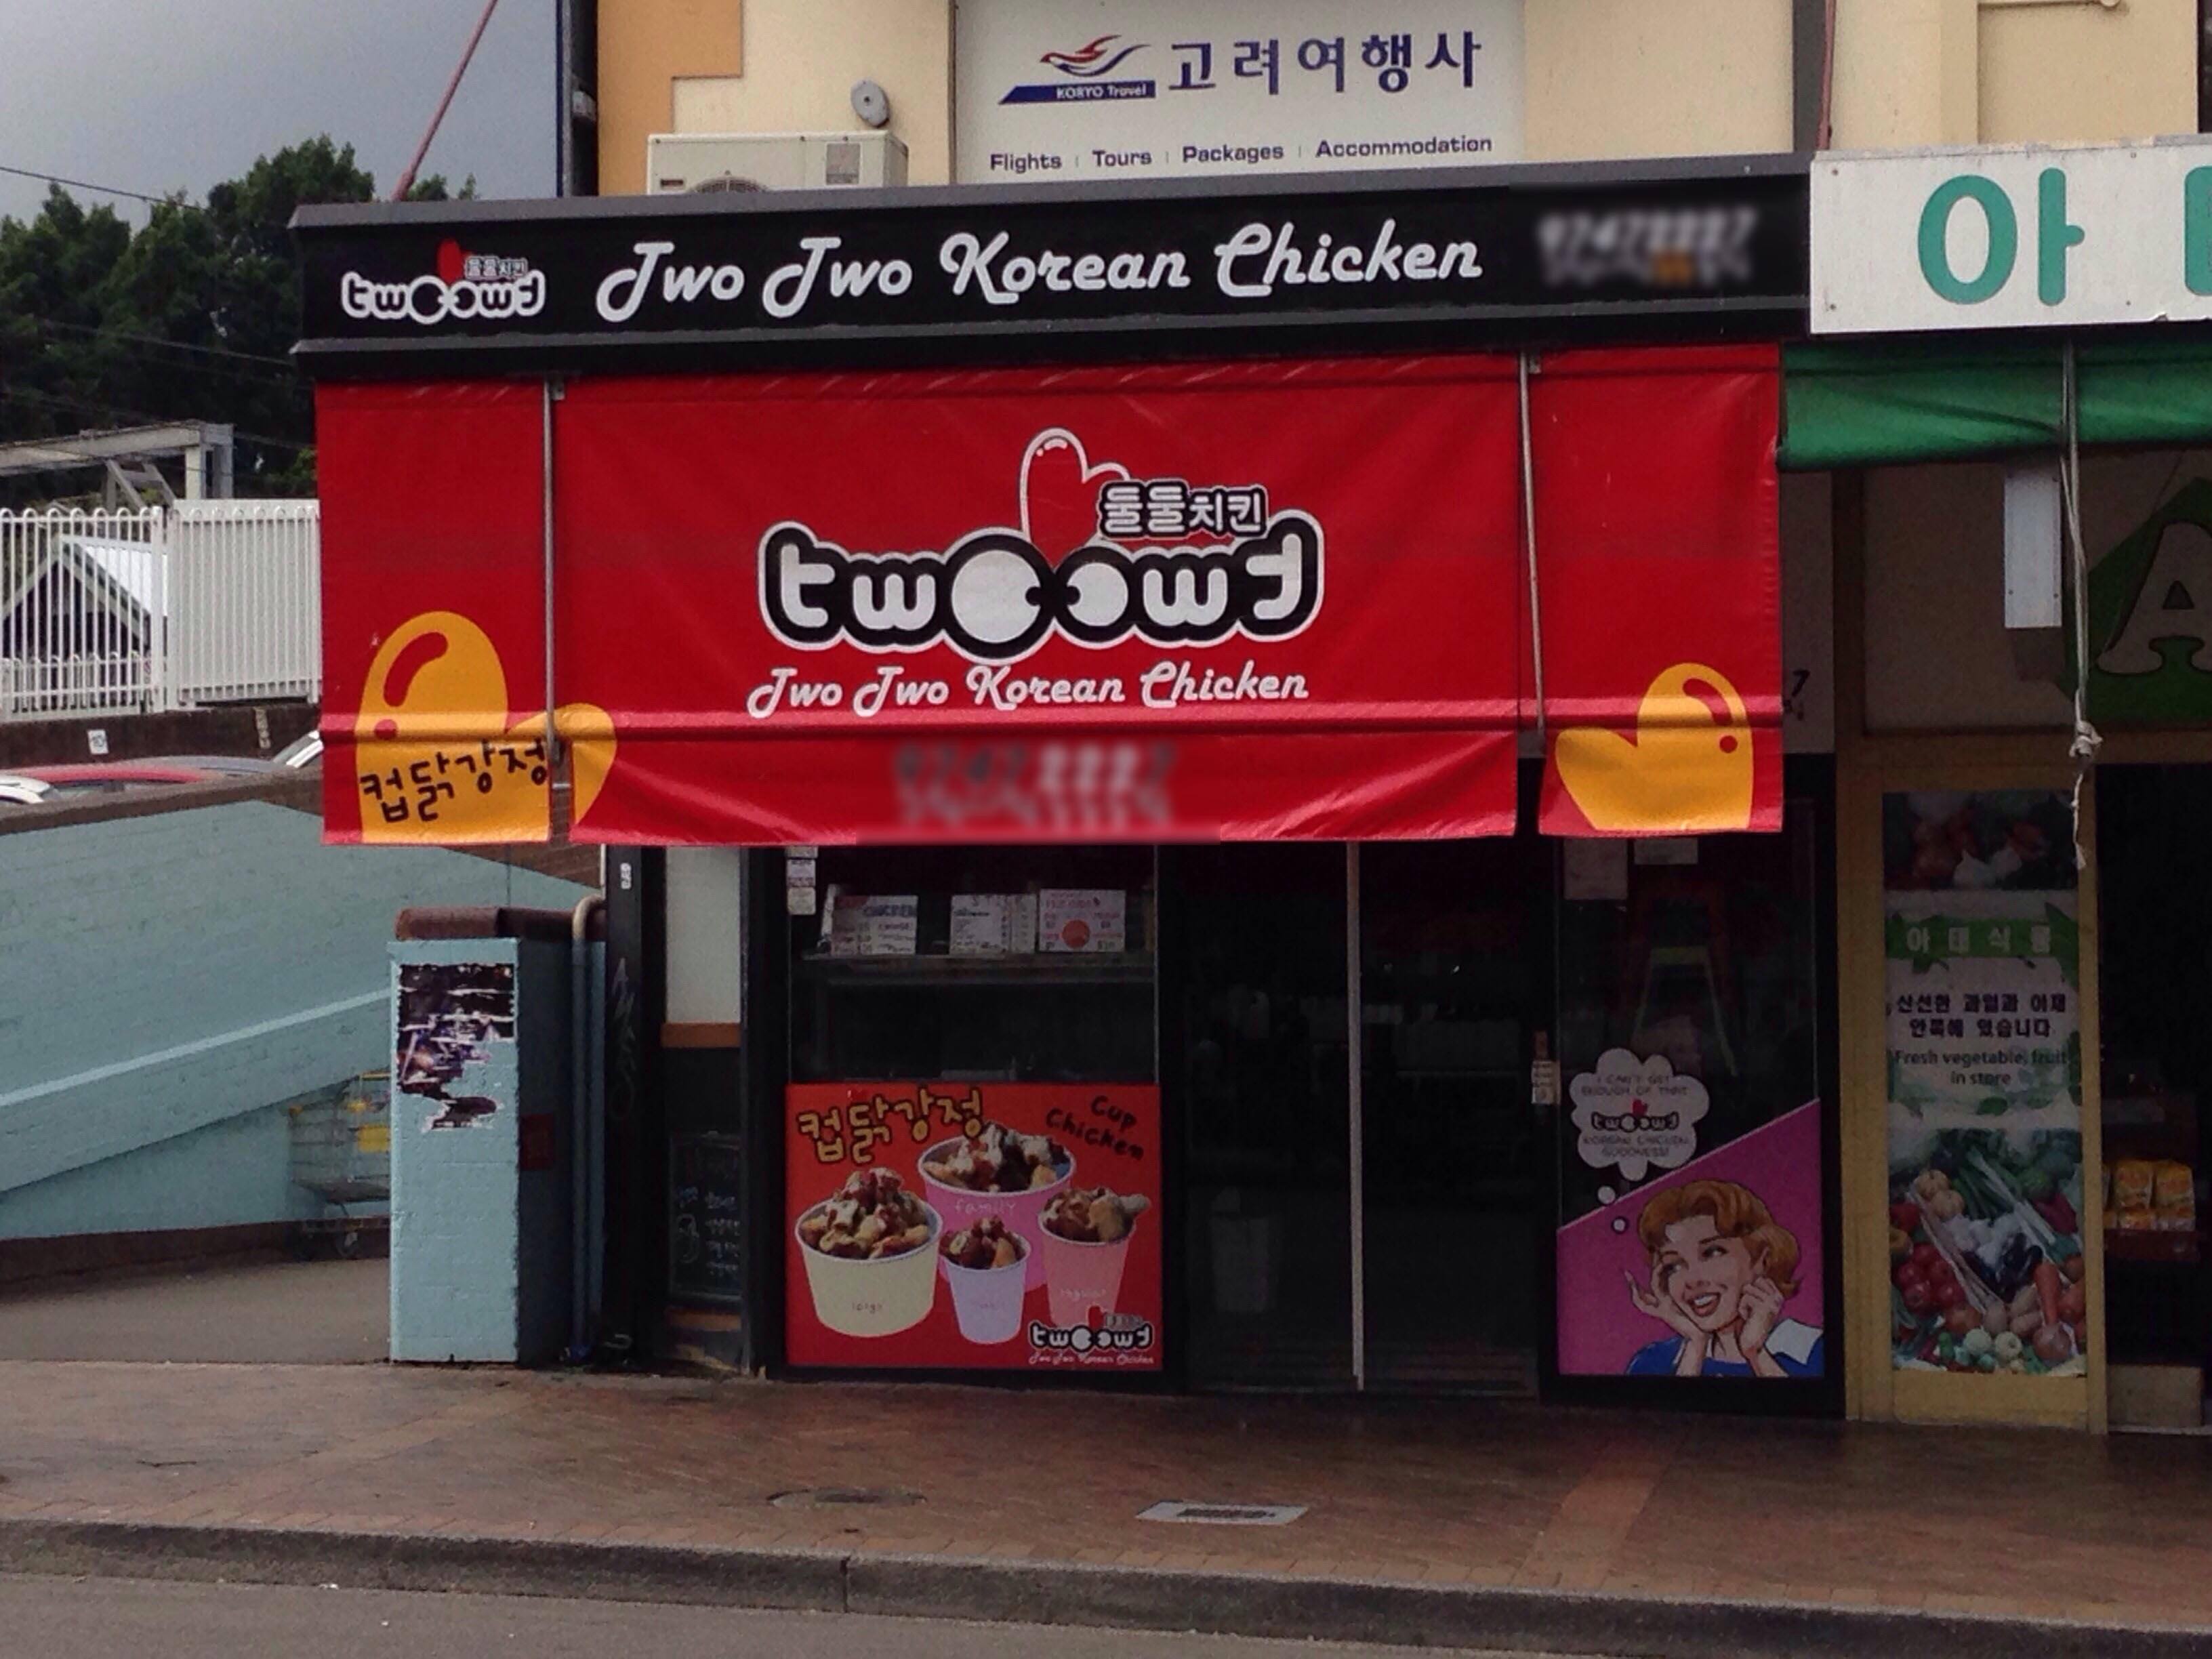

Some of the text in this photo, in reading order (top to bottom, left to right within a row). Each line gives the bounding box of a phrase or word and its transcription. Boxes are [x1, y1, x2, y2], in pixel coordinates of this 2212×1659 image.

[1167, 30, 1482, 96] 고려여행사
[1057, 83, 1147, 99] KORYO Travel
[989, 135, 1493, 174] Flights Tours Packages Accommodation
[596, 241, 745, 323] Two
[762, 237, 913, 319] Two
[939, 230, 1191, 305] Korean
[1214, 218, 1483, 298] Chicken
[1102, 483, 1265, 537] 둘둘치킨
[747, 659, 1309, 719] Two Two Korean Chicken
[359, 737, 549, 823] 컵닭강정
[1896, 1050, 1938, 1064] Fresh
[1950, 1071, 2011, 1085] in store
[796, 1087, 983, 1164] 컵닭강정
[1046, 1107, 1145, 1161] Chicken
[1090, 1095, 1137, 1133] Cup
